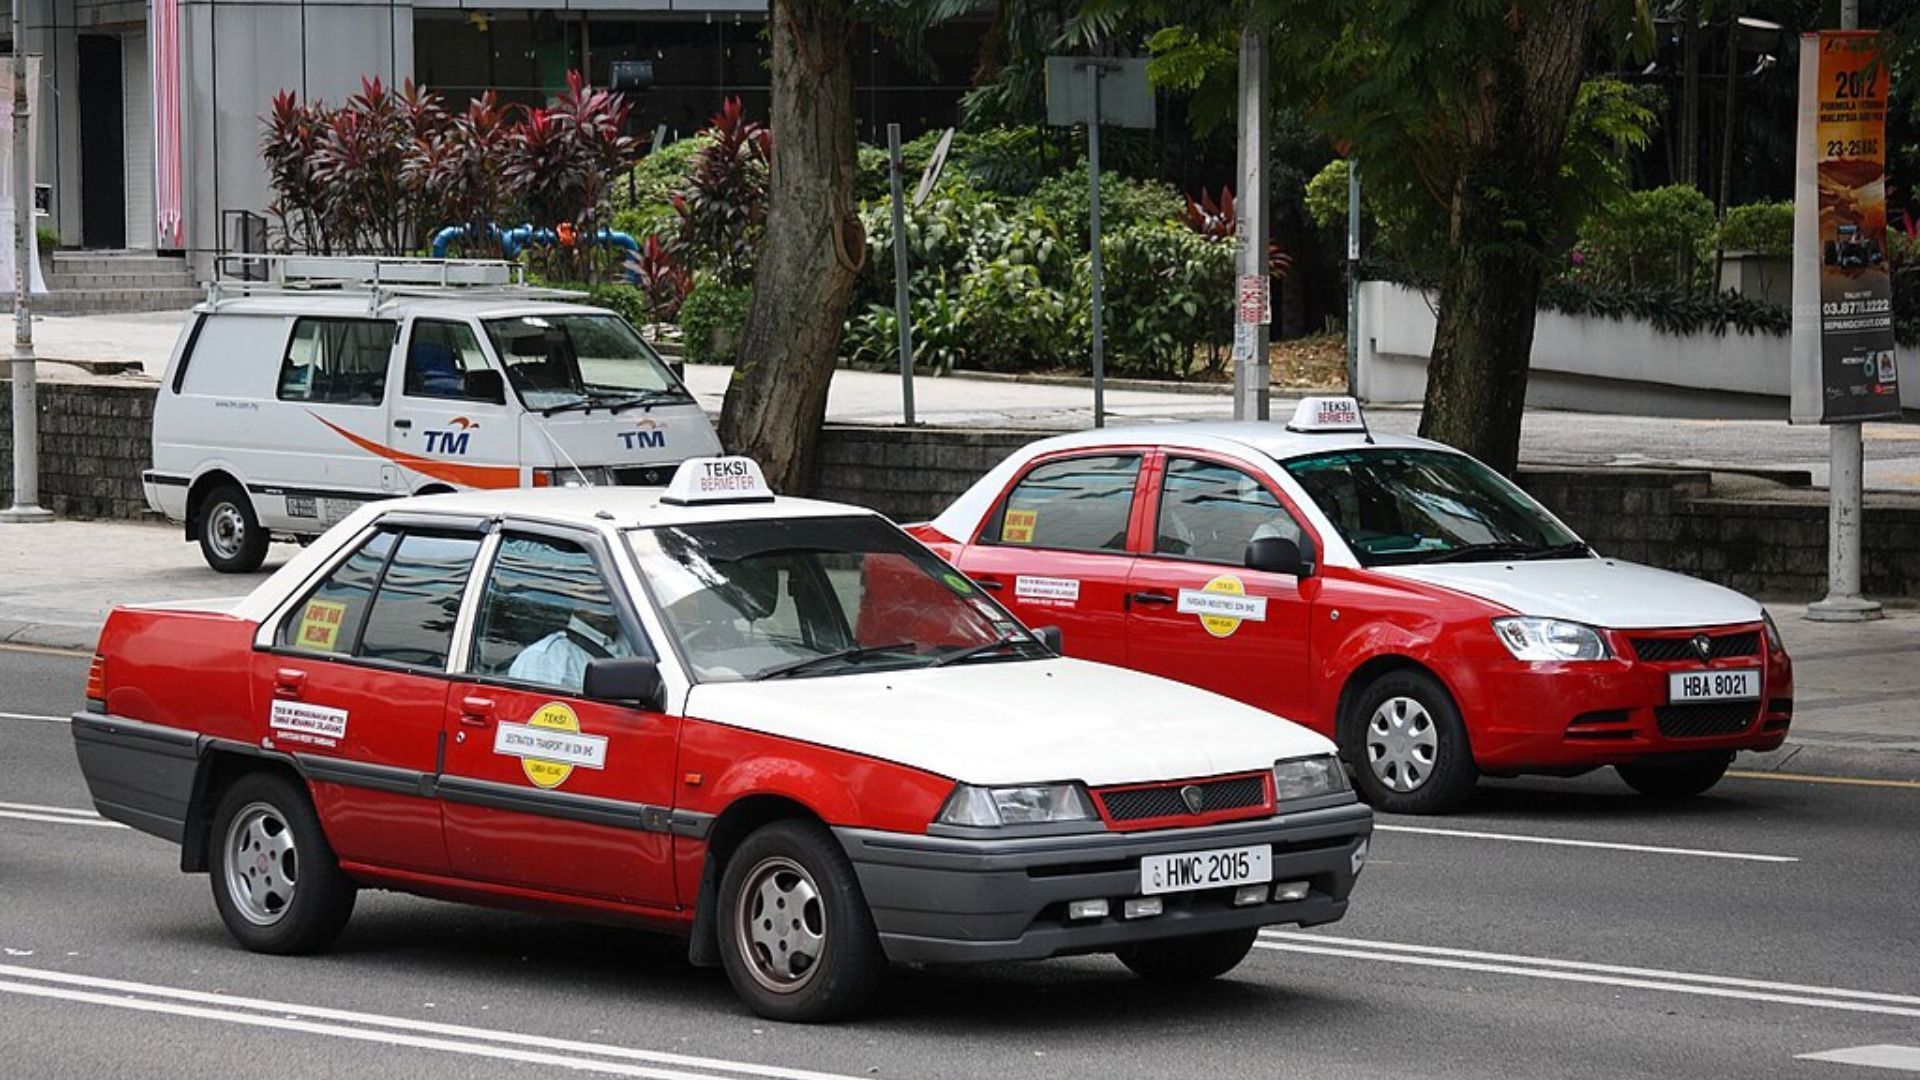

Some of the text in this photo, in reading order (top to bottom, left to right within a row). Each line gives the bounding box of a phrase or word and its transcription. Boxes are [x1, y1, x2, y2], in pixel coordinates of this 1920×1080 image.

[1322, 401, 1351, 412] TEKSI
[1318, 412, 1356, 424] BERMETER
[423, 430, 470, 455] TM
[617, 431, 666, 450] TM
[704, 461, 748, 477] TEKSI
[700, 476, 755, 492] BERMETER
[1683, 674, 1747, 697] HBA 8021
[543, 712, 567, 725] TEKSI
[1167, 851, 1250, 887] HWC 2015
